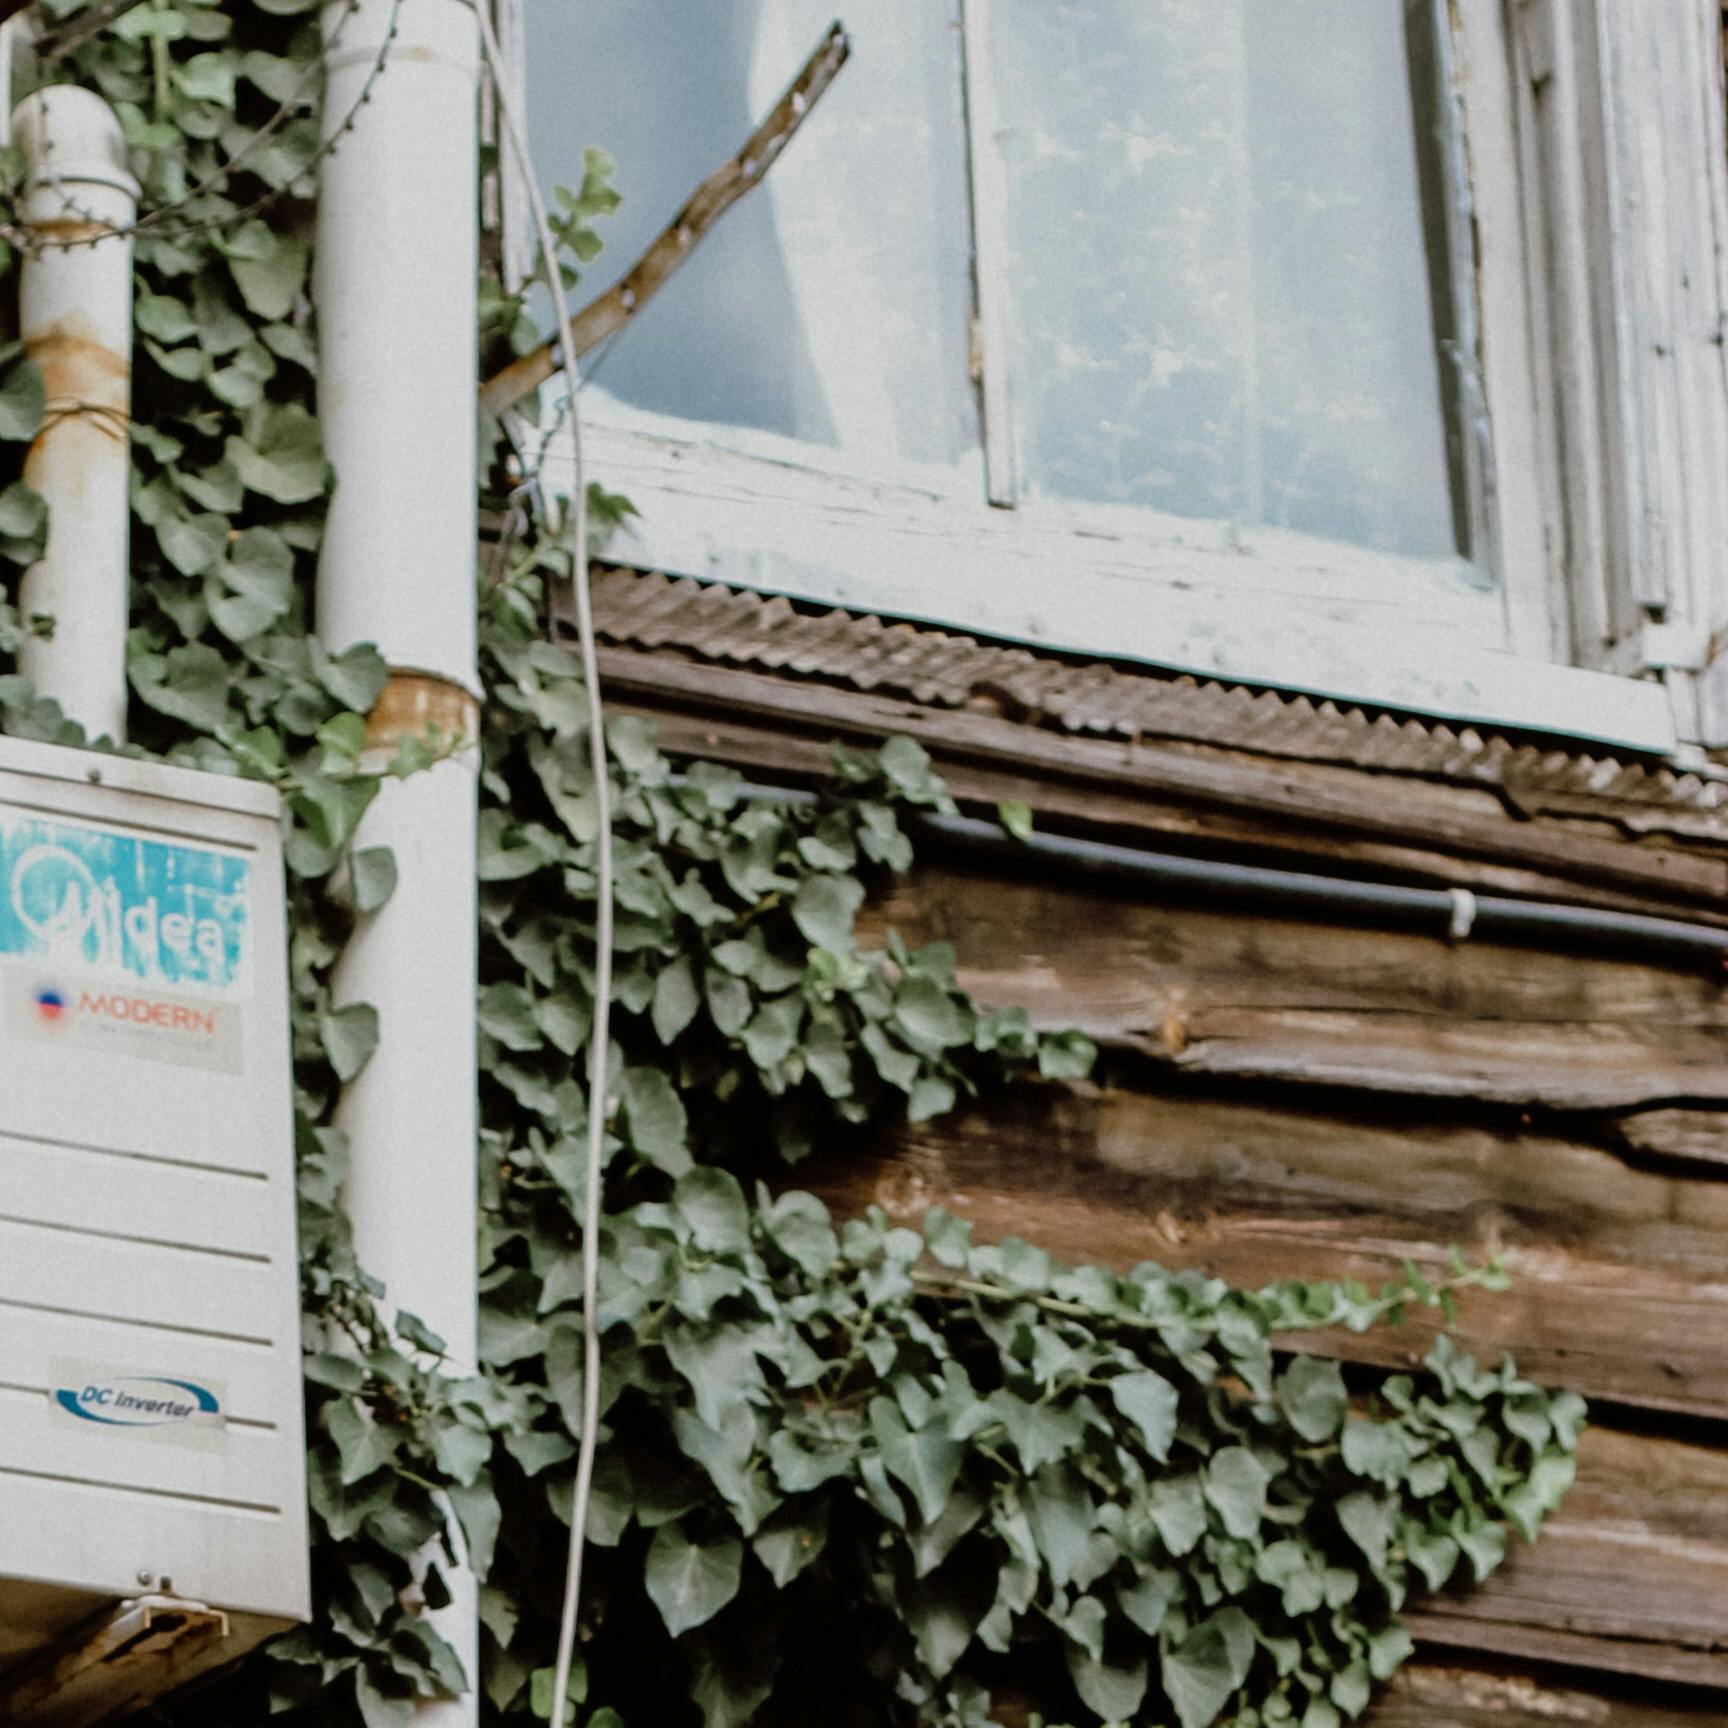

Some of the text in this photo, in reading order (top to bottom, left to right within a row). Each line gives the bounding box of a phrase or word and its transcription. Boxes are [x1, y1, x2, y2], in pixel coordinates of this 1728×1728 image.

[38, 866, 227, 963] Midea
[79, 992, 215, 1035] MODERN
[81, 1385, 194, 1418] DC Inverter
